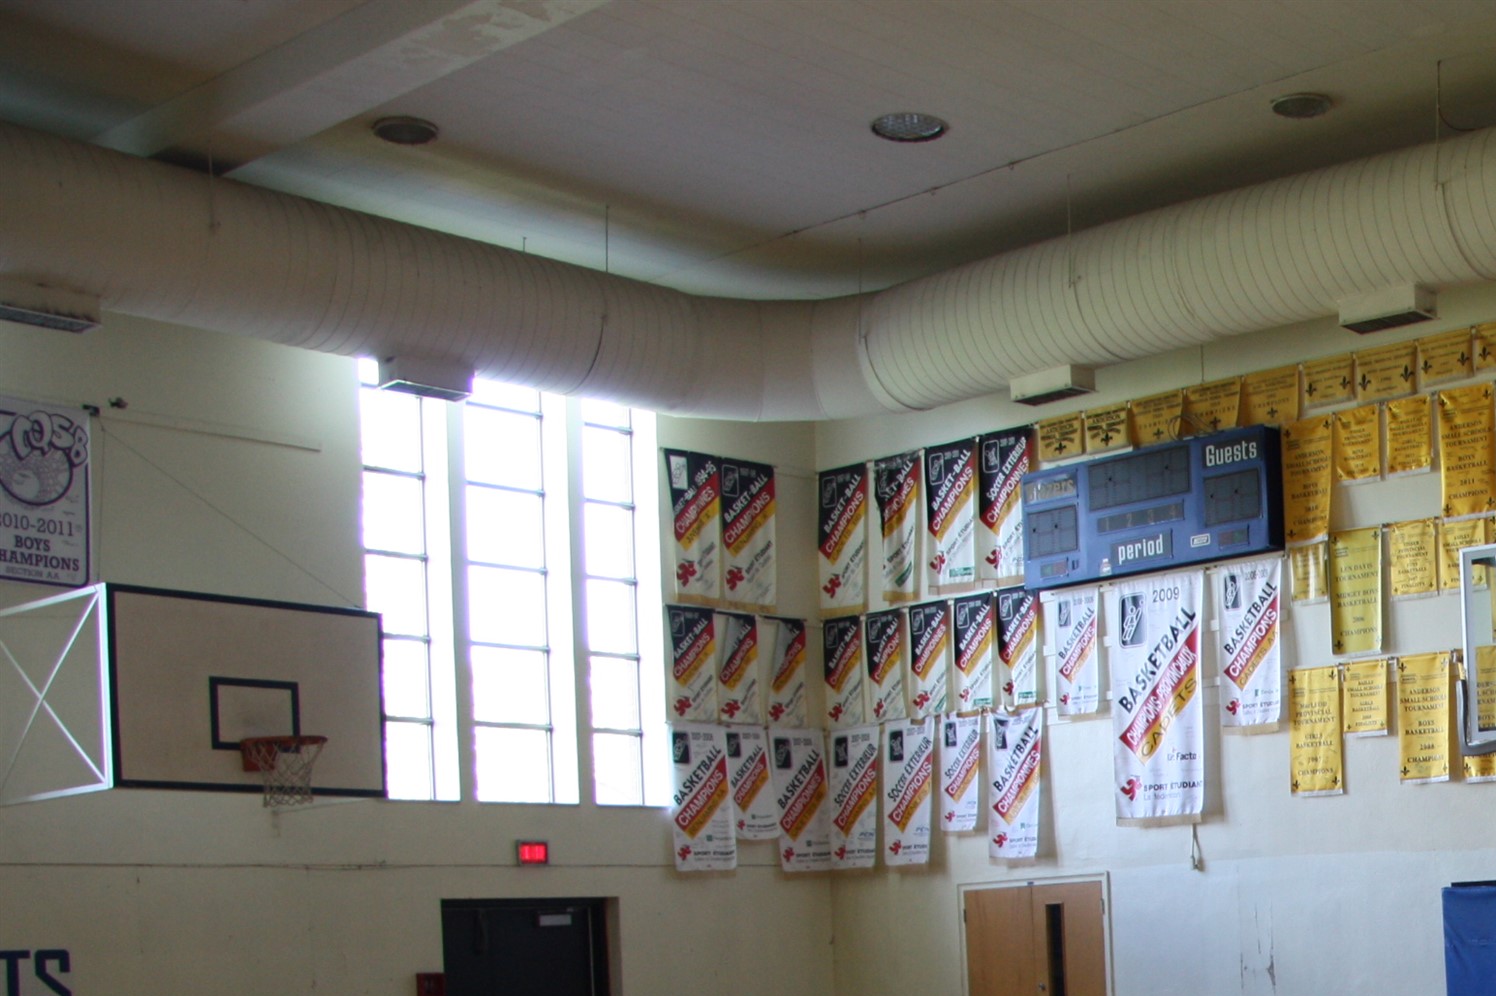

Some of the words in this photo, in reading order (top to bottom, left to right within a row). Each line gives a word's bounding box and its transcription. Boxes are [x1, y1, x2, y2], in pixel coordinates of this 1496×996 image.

[932, 449, 971, 511] BASKET-BALL
[1205, 439, 1258, 468] Guests
[824, 473, 862, 534] BASKET-BALL
[932, 465, 974, 532] CHAMPIONS
[987, 456, 1029, 524] CHAMPIONNES
[1448, 488, 1488, 500] CHAMPIONS
[14, 534, 51, 552] BOYS
[725, 491, 771, 544] CHAMPIONS
[826, 492, 864, 554] CHAMPIONS
[1118, 533, 1164, 565] period
[1003, 594, 1034, 643] BASKET-BALL
[1153, 585, 1180, 603] 2009
[1223, 581, 1278, 656] BASKETBALL
[914, 610, 944, 655] BASKET-BALL
[915, 625, 947, 674] CHAMPIONNES
[959, 603, 990, 651] BASKET-BALL
[959, 618, 993, 670] CHAMPIONS
[1003, 610, 1036, 661] CHAMPIONS
[1058, 606, 1095, 660] BASKETBALL
[1062, 625, 1096, 676] CHAMPIONS
[1229, 608, 1278, 677] CHAMPIONS
[674, 633, 711, 678] CHAMPIONS
[1118, 605, 1197, 715] BASKETBALL
[1238, 646, 1267, 686] CADETS
[1126, 692, 1161, 745] CHAMPIONS
[1157, 645, 1198, 701] PROVINCIAUX
[1140, 677, 1198, 758] CADETS
[1408, 687, 1441, 695] ANDERSON
[1417, 719, 1436, 727] BOYS
[675, 746, 722, 807] BASKETBALL
[730, 744, 763, 790] BASKETBALL
[735, 762, 766, 804] CHAMPIONS
[776, 748, 820, 811] BASKETBALL
[948, 749, 980, 795] CHAMPIONS
[993, 726, 1039, 793] BASKETBALL
[997, 750, 1041, 814] CHAMPIONNES
[678, 769, 724, 828] CHAMPIONS
[782, 773, 822, 830] CHAMPIONNES
[837, 769, 877, 827] CHAMPIONS
[892, 762, 932, 822] CHAMPIONS
